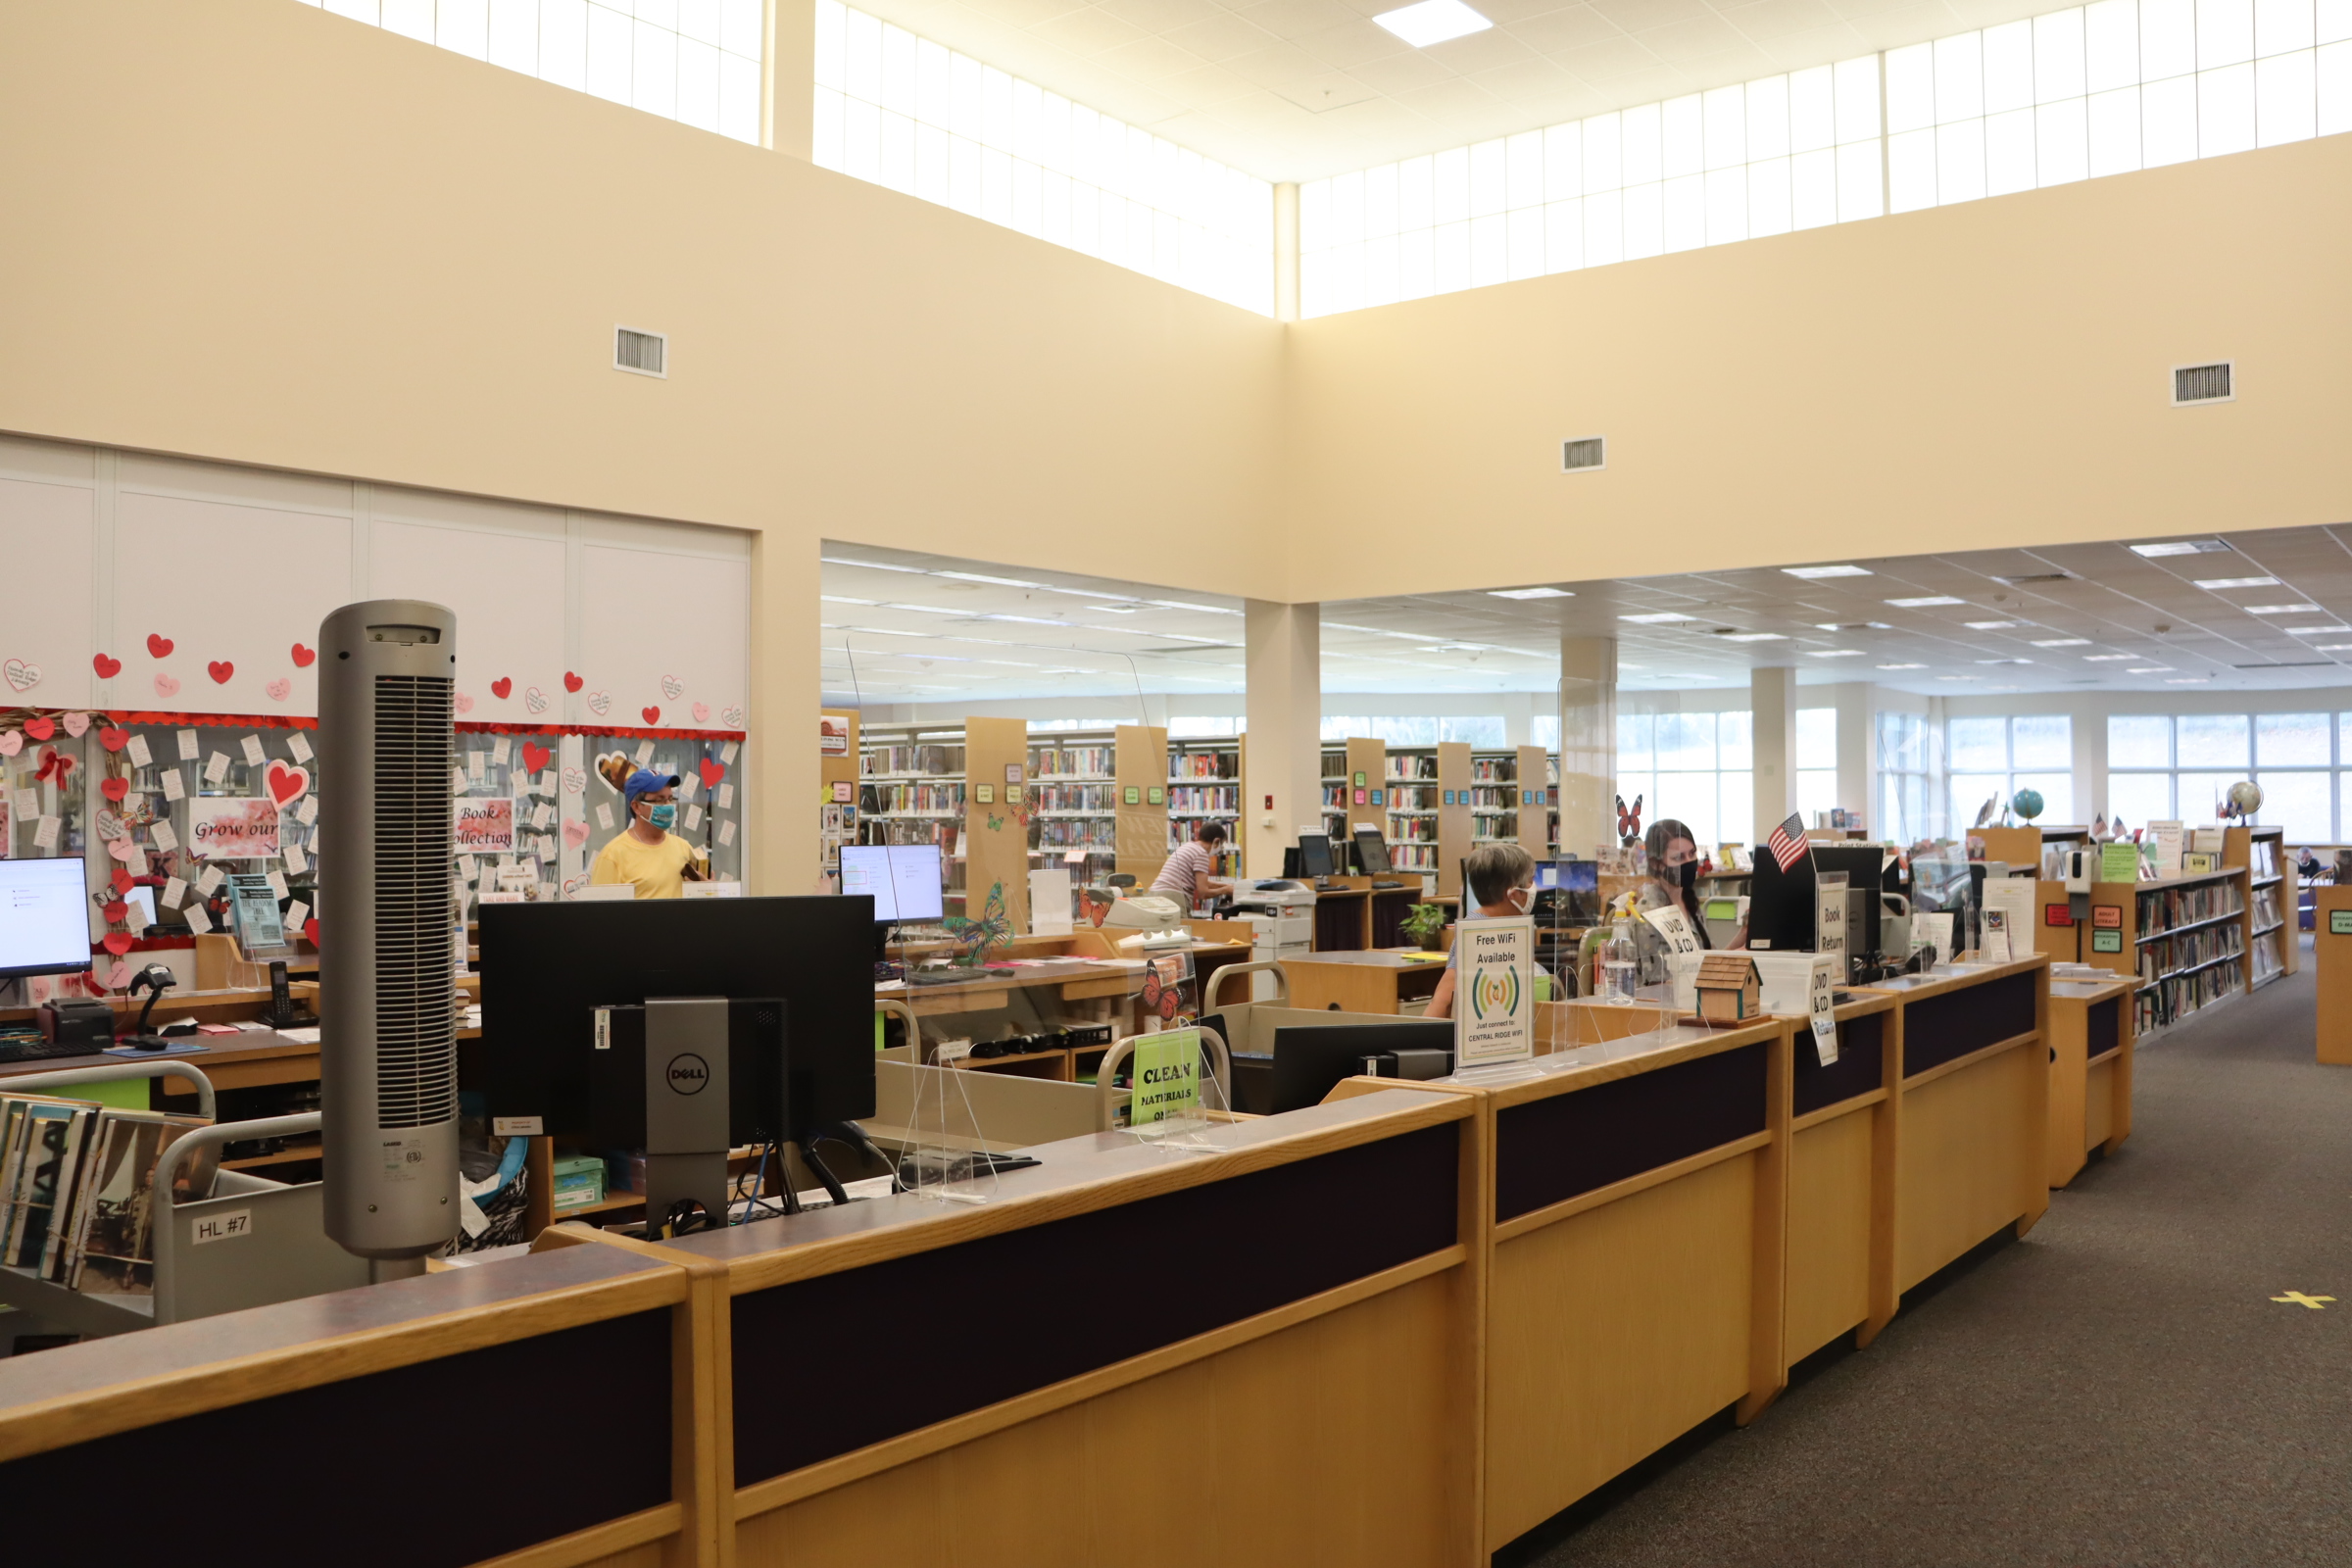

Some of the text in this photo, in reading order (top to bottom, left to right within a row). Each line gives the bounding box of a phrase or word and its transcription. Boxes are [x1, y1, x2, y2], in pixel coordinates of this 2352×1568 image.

[461, 806, 496, 819] Book
[195, 821, 278, 840] Grow our
[453, 830, 512, 845] ollection
[1825, 907, 1840, 923] Book
[1663, 919, 1684, 933] DVD
[1476, 933, 1516, 946] Free WiFi
[1683, 939, 1693, 953] CD
[1822, 936, 1842, 951] Return
[1477, 952, 1515, 964] Available
[1815, 972, 1827, 990] DVD
[1814, 996, 1829, 1013] & CD
[1488, 1019, 1508, 1028] connect
[1814, 1021, 1835, 1037] Return
[1468, 1032, 1494, 1043] CENTRAL
[1494, 1031, 1511, 1040] RIDGE
[671, 1068, 705, 1080] DELL
[1143, 1062, 1191, 1084] CLEAN
[200, 1215, 247, 1239] HL #7
